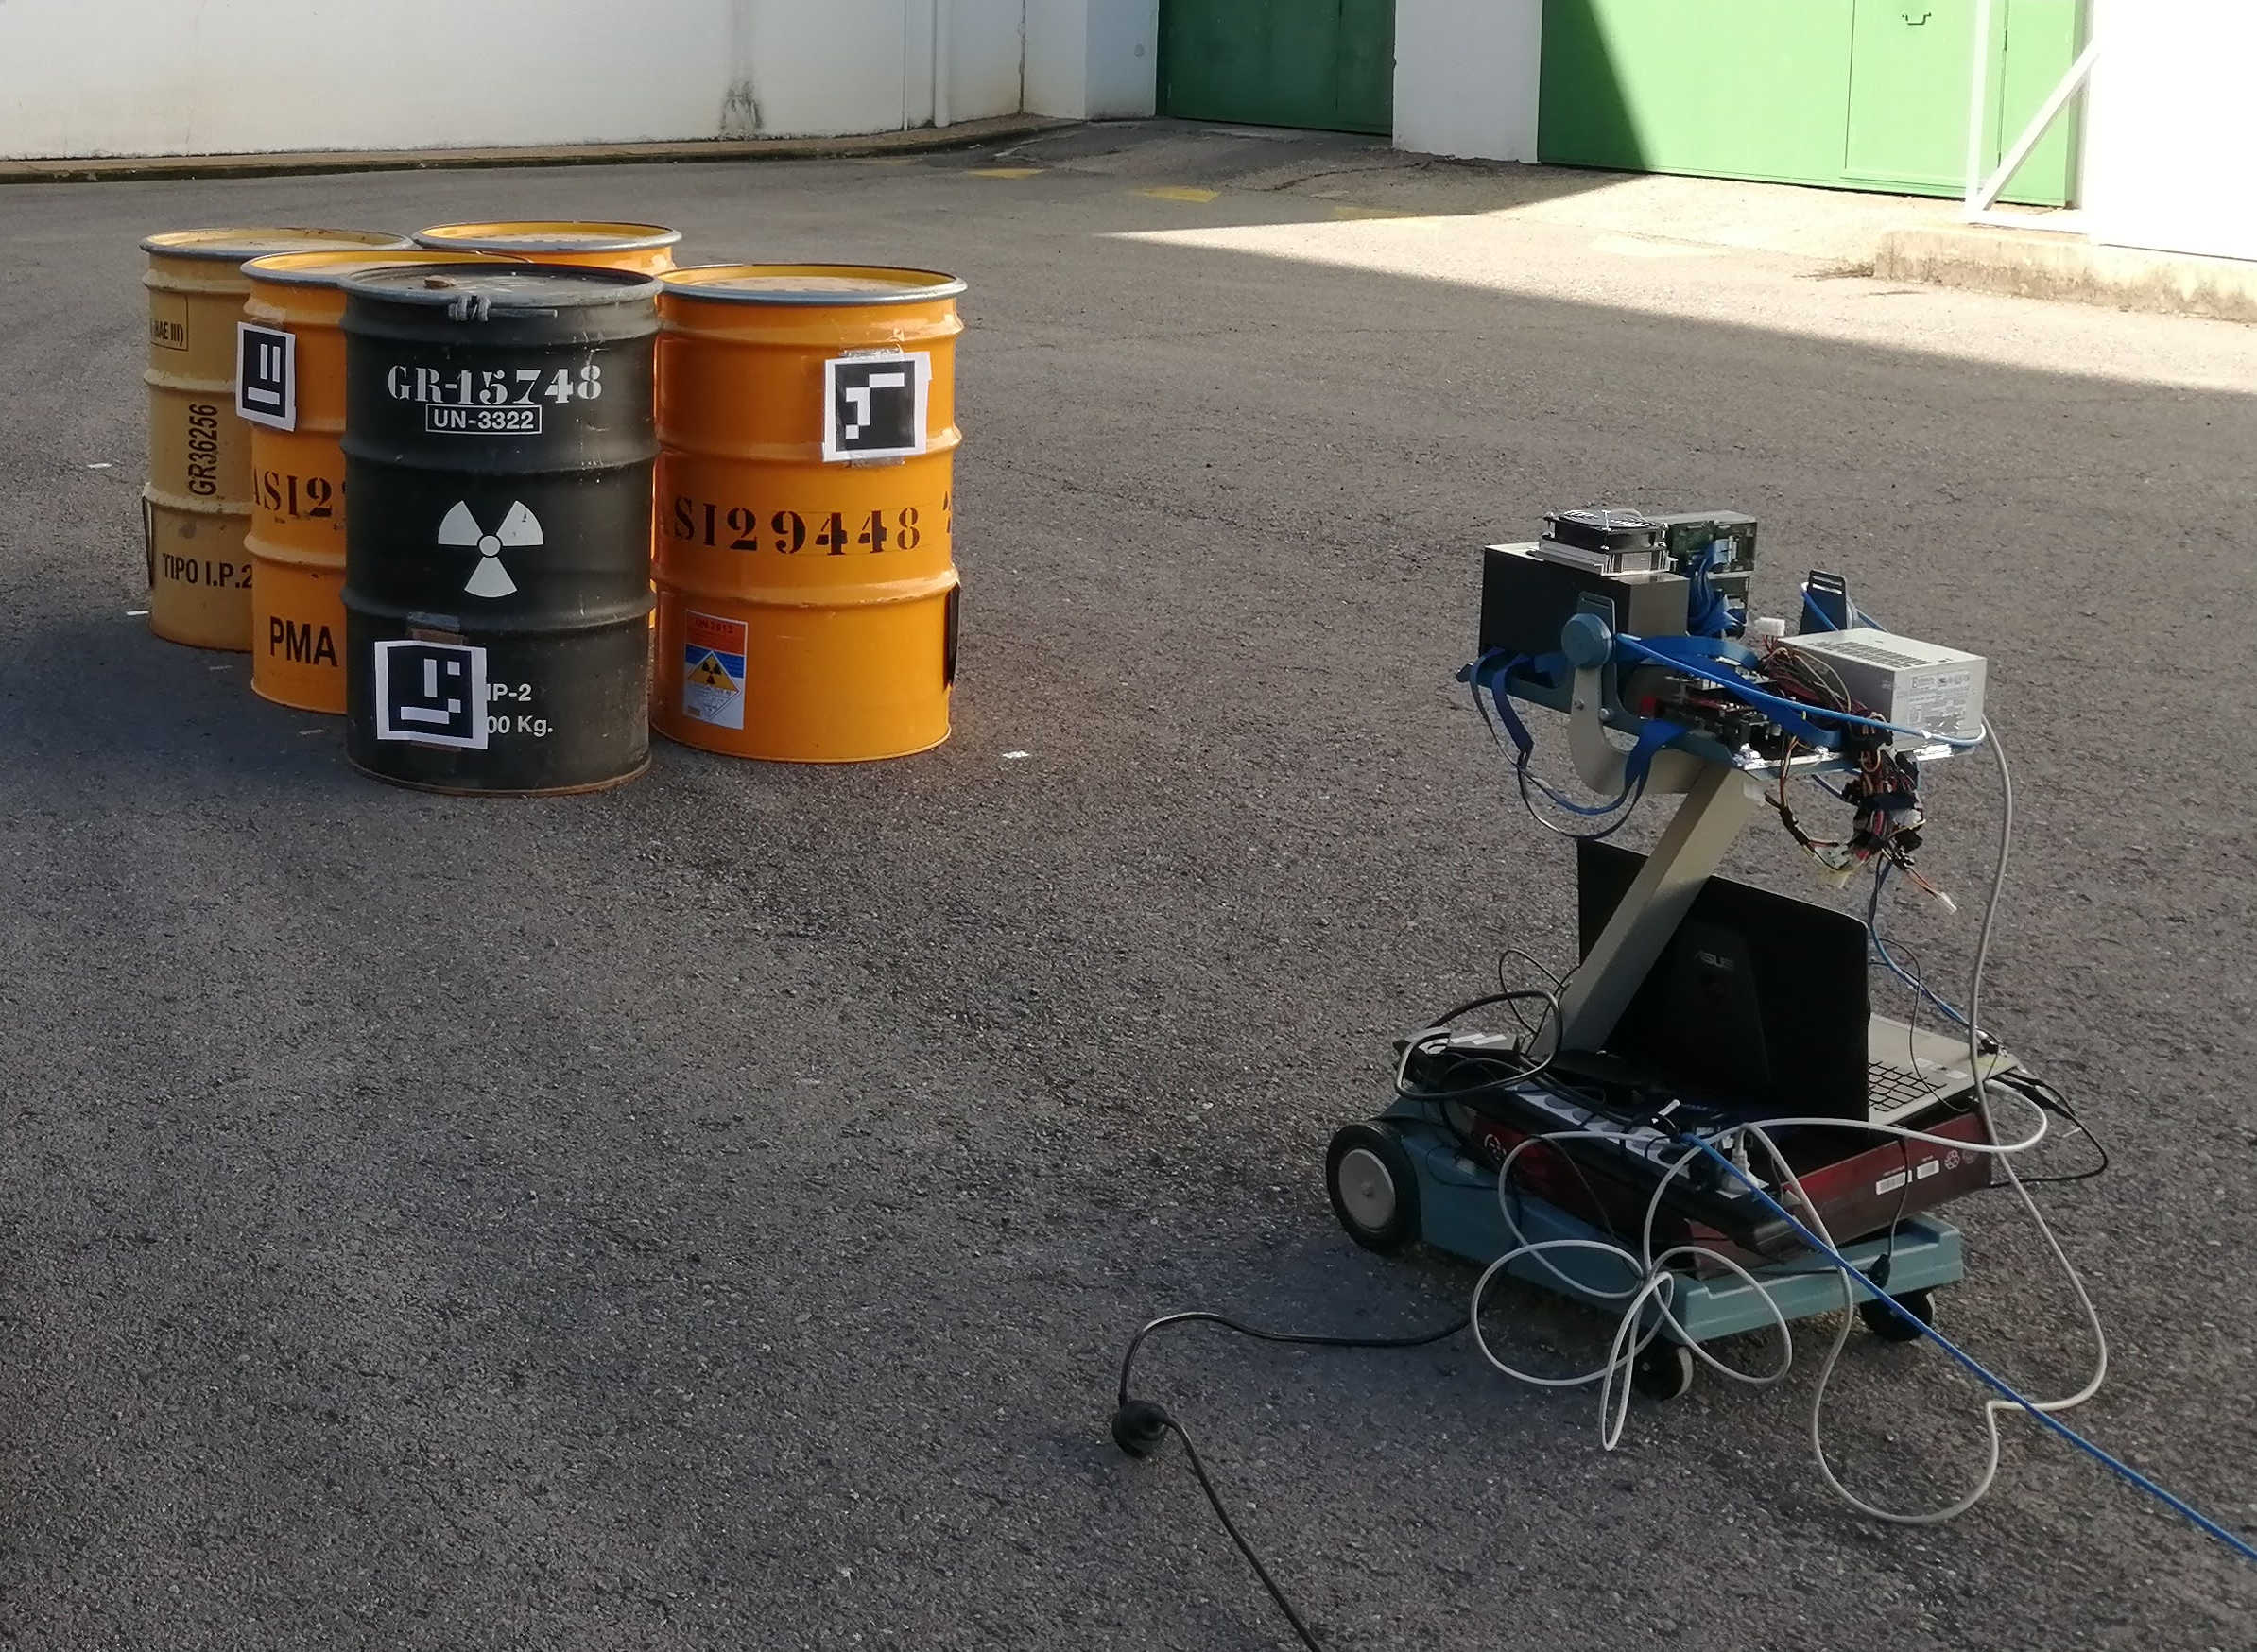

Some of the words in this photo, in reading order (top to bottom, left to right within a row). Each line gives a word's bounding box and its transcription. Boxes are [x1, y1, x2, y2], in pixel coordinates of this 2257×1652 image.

[388, 364, 603, 405] GR-15748
[433, 409, 534, 430] UN-3322
[188, 404, 218, 496] GR36256
[163, 553, 198, 584] TIPO
[269, 616, 338, 668] PMA
[517, 715, 553, 737] Kg.
